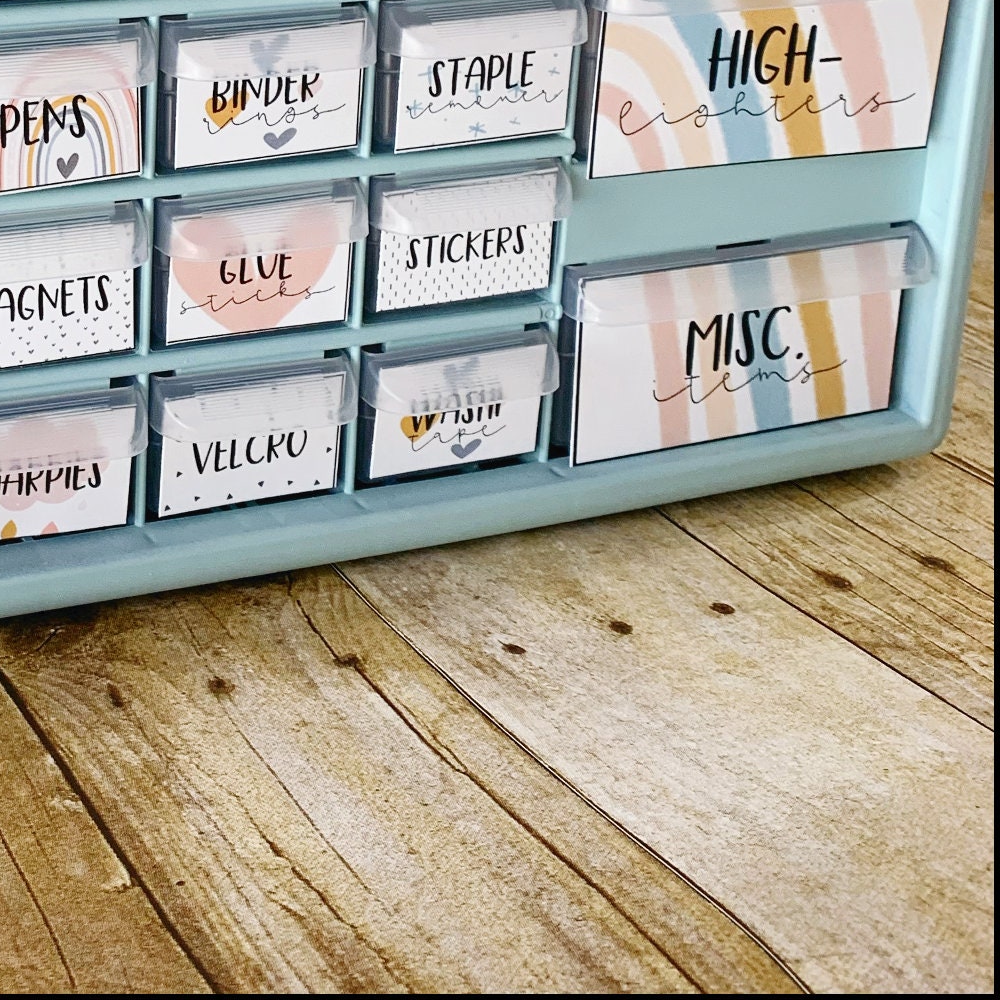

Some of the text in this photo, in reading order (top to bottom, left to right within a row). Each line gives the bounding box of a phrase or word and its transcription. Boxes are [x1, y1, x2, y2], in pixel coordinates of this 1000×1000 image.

[429, 51, 537, 98] STAPLE
[708, 23, 842, 92] HIGH-
[212, 66, 320, 113] BINDER
[406, 89, 564, 120] remover
[0, 94, 87, 149] PENS
[203, 104, 346, 135] rings
[619, 91, 916, 136] lighters
[220, 248, 292, 284] GLUE
[406, 224, 528, 271] STICKERS
[180, 281, 335, 315] sticks
[686, 306, 804, 375] MISC.
[653, 359, 847, 404] items
[192, 428, 307, 474] VELCRO
[408, 424, 506, 451] tape
